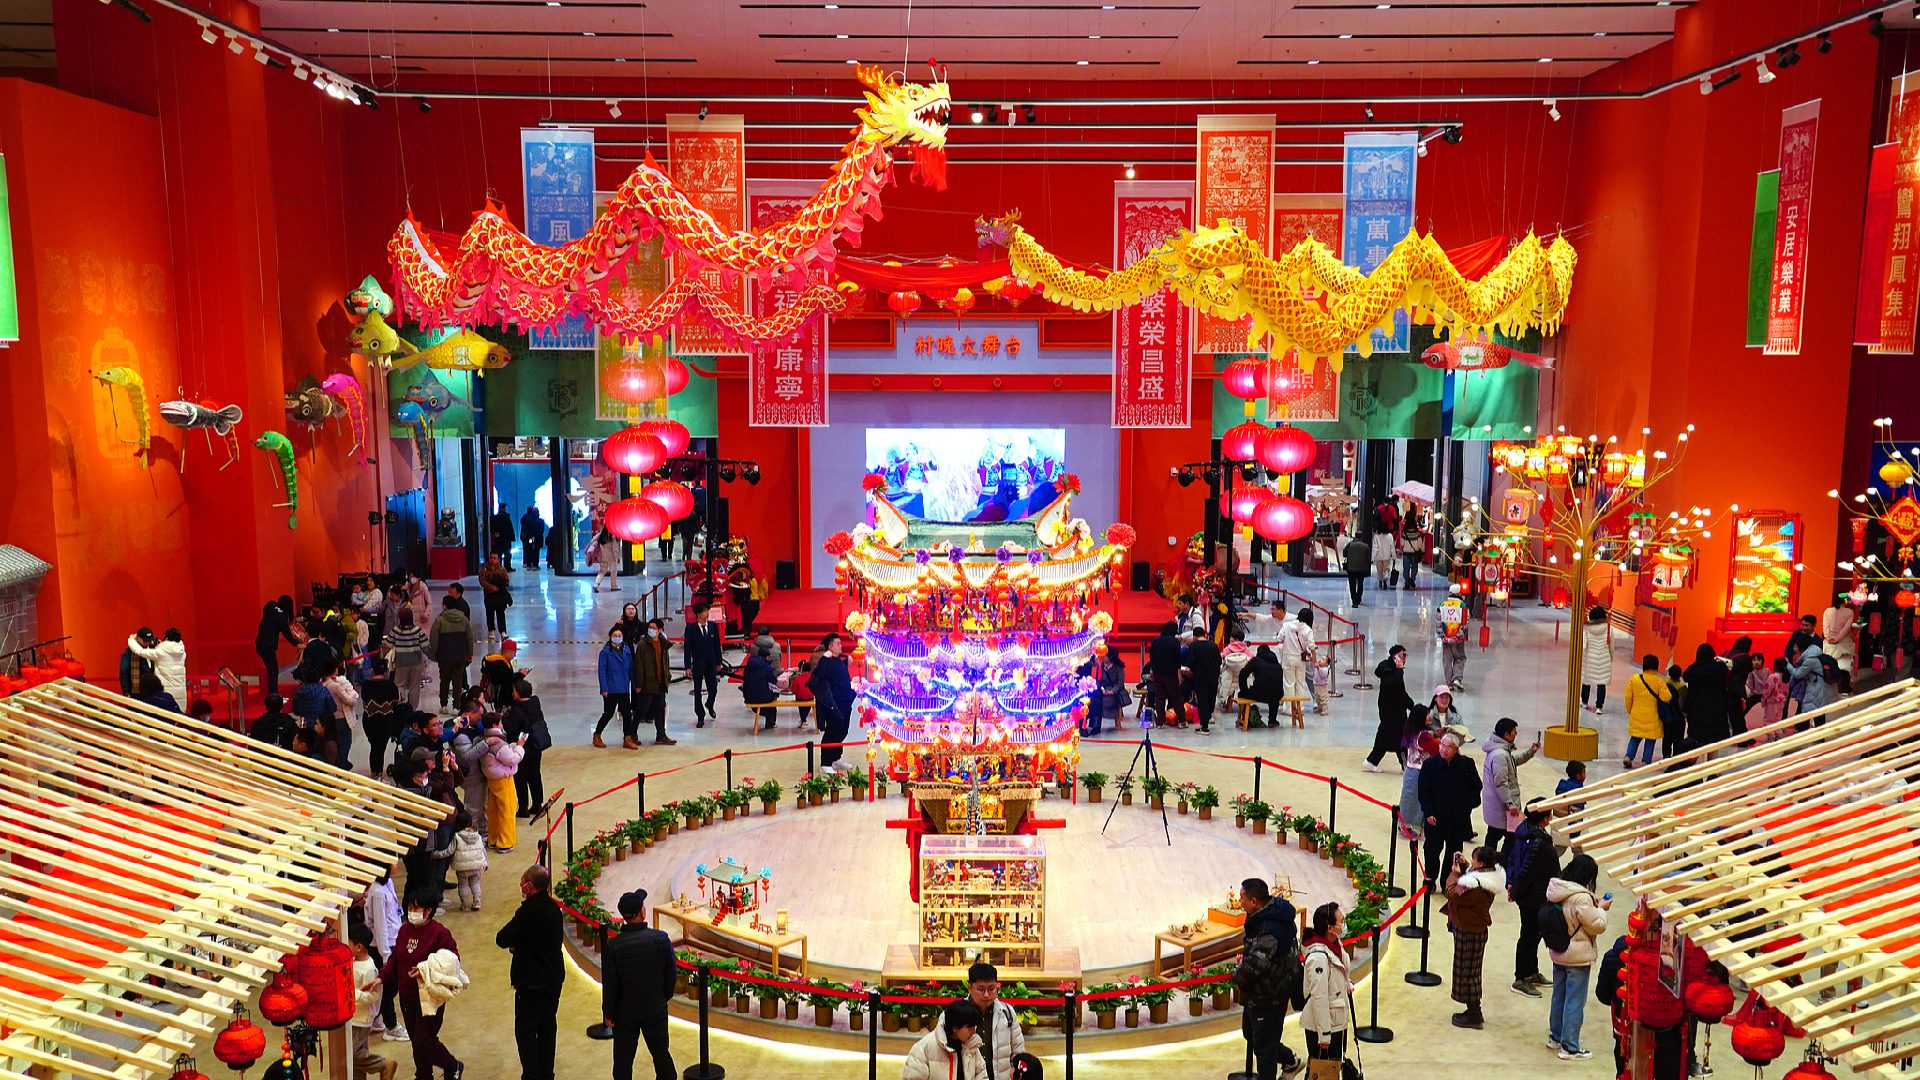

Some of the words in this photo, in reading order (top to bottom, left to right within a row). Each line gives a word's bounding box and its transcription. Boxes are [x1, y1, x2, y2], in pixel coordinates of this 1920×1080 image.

[548, 220, 576, 243] 風
[1365, 218, 1390, 268] 萬事
[1778, 204, 1798, 313] 安居樂業
[1885, 187, 1914, 317] 鸞翔鳳集
[774, 290, 804, 400] 福康寧
[914, 333, 1022, 355] 村晚大舞台
[1137, 287, 1166, 400] 繁榮昌盛
